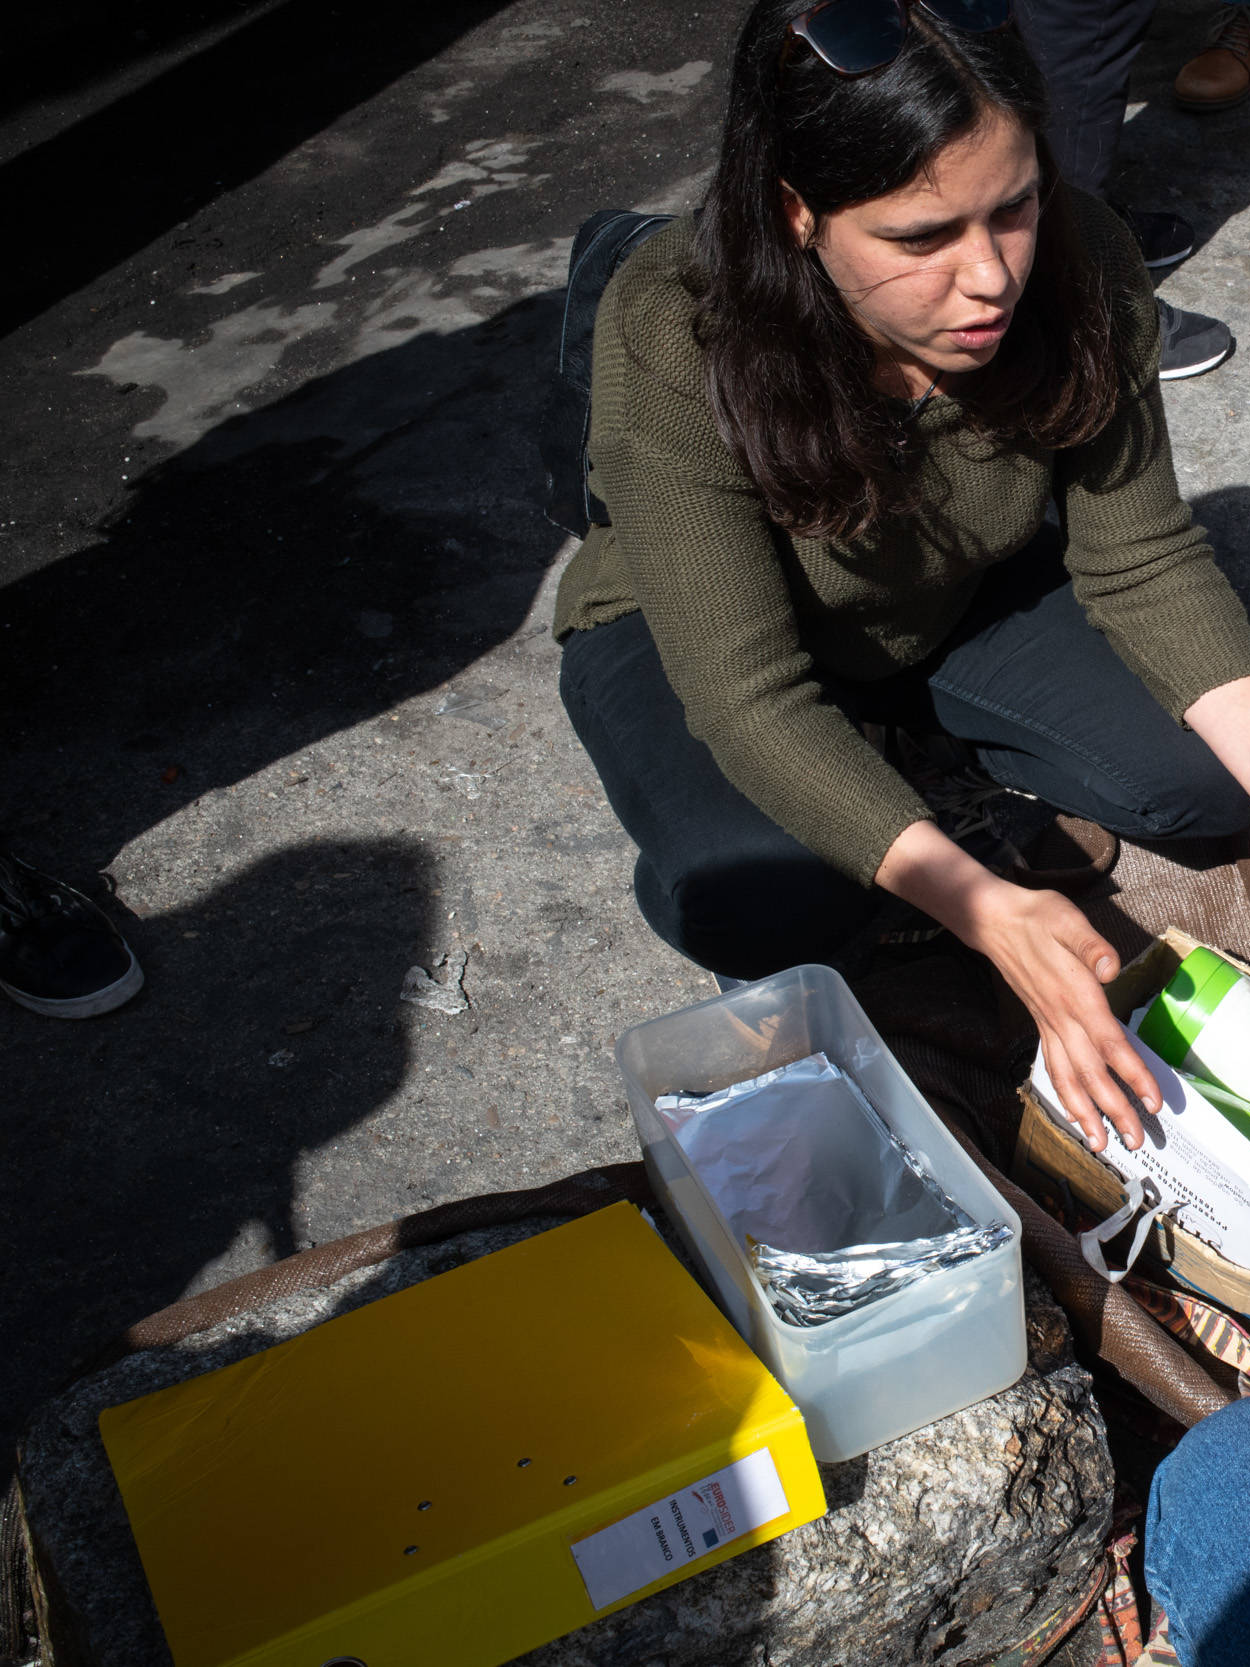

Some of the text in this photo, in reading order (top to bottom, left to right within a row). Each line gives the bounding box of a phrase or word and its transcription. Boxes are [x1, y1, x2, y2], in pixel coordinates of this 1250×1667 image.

[1141, 1159, 1153, 1172] em
[1172, 1176, 1214, 1213] Testados
[651, 1516, 673, 1561] EM BRANCO
[669, 1499, 697, 1557] INSTRUMENTOS
